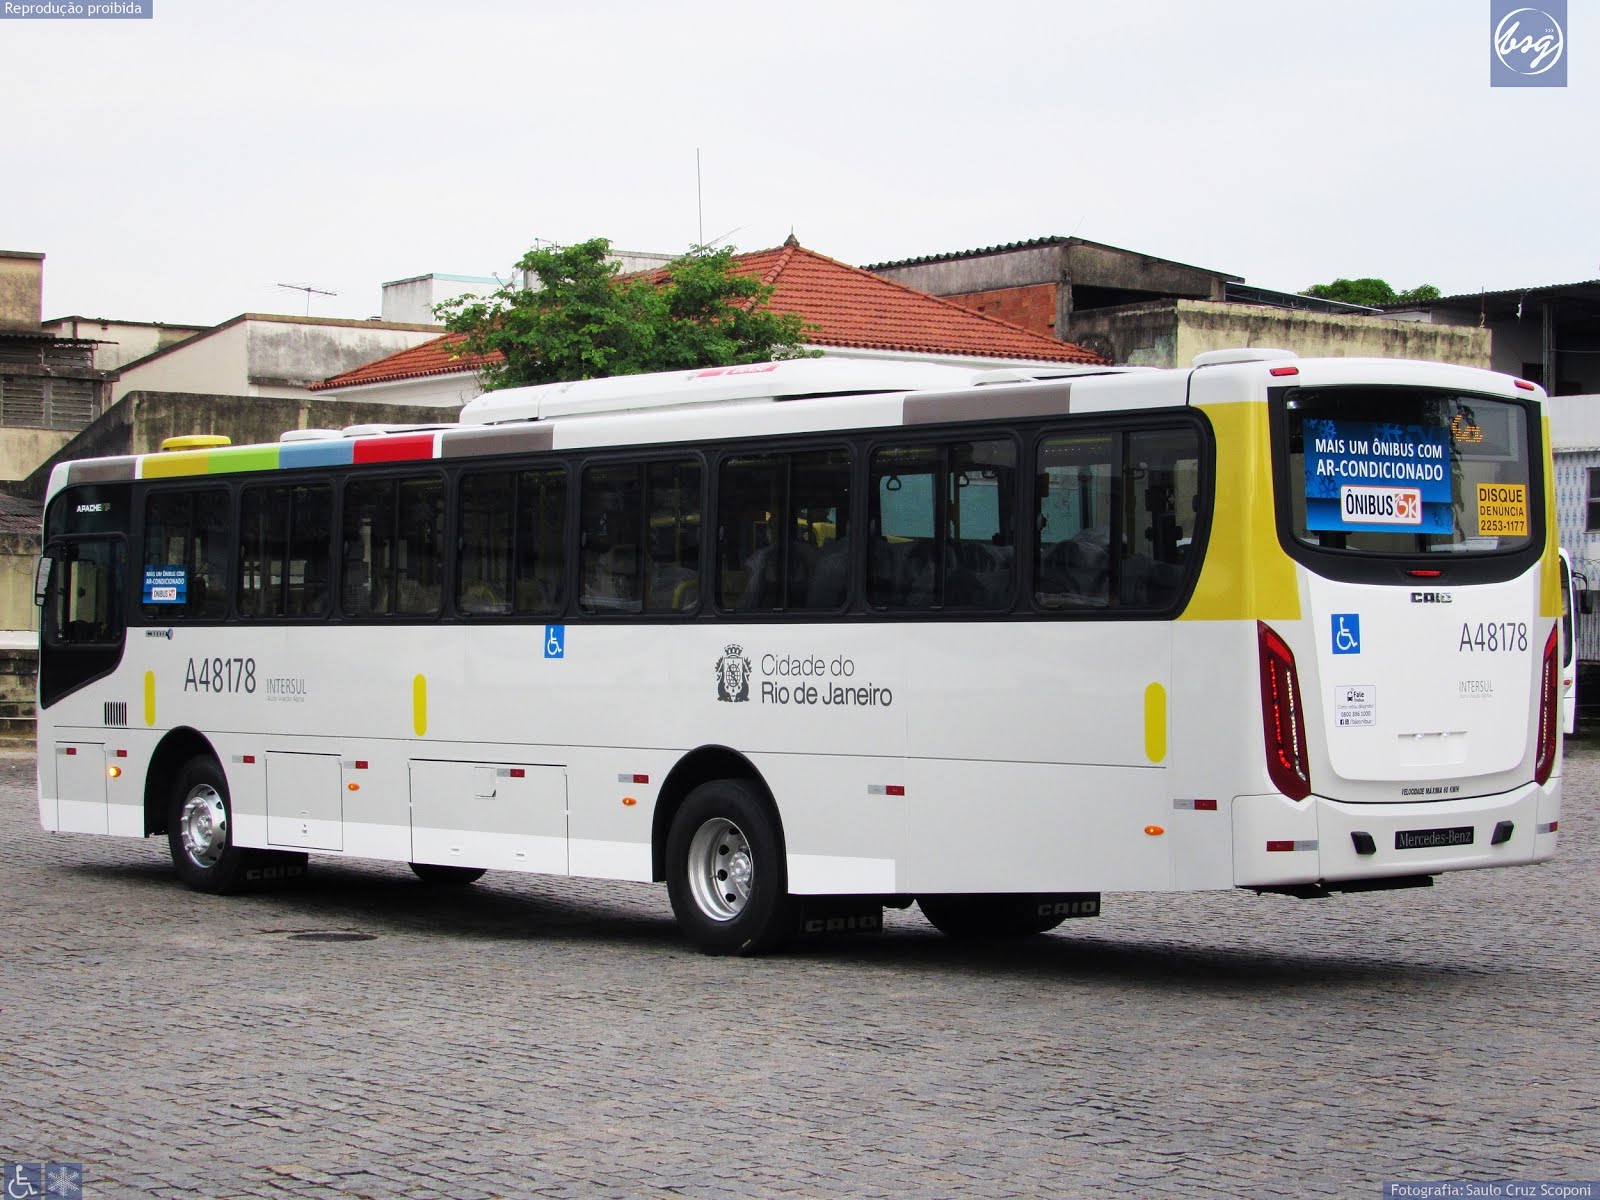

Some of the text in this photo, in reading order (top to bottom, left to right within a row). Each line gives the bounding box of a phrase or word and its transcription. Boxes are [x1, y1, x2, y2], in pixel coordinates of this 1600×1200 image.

[1315, 438, 1442, 459] MAIS UM ÔNIBUS COM
[1316, 459, 1443, 481] AR-CONDICIONADO
[1345, 489, 1393, 516] ÔNIBUS
[1479, 488, 1523, 503] DISQUE
[76, 503, 102, 512] APACHE
[1480, 503, 1524, 516] DENÚNCIA
[1480, 520, 1525, 532] 2253-1177
[1459, 622, 1528, 652] A48178
[761, 654, 855, 677] Cidade do
[184, 657, 257, 694] A48178
[266, 678, 307, 695] INTERSUL
[761, 681, 893, 707] Rio de Janeiro
[1459, 680, 1494, 692] INTERSUL
[1400, 830, 1471, 847] Mercedes-Benz
[1037, 900, 1097, 917] CAIO
